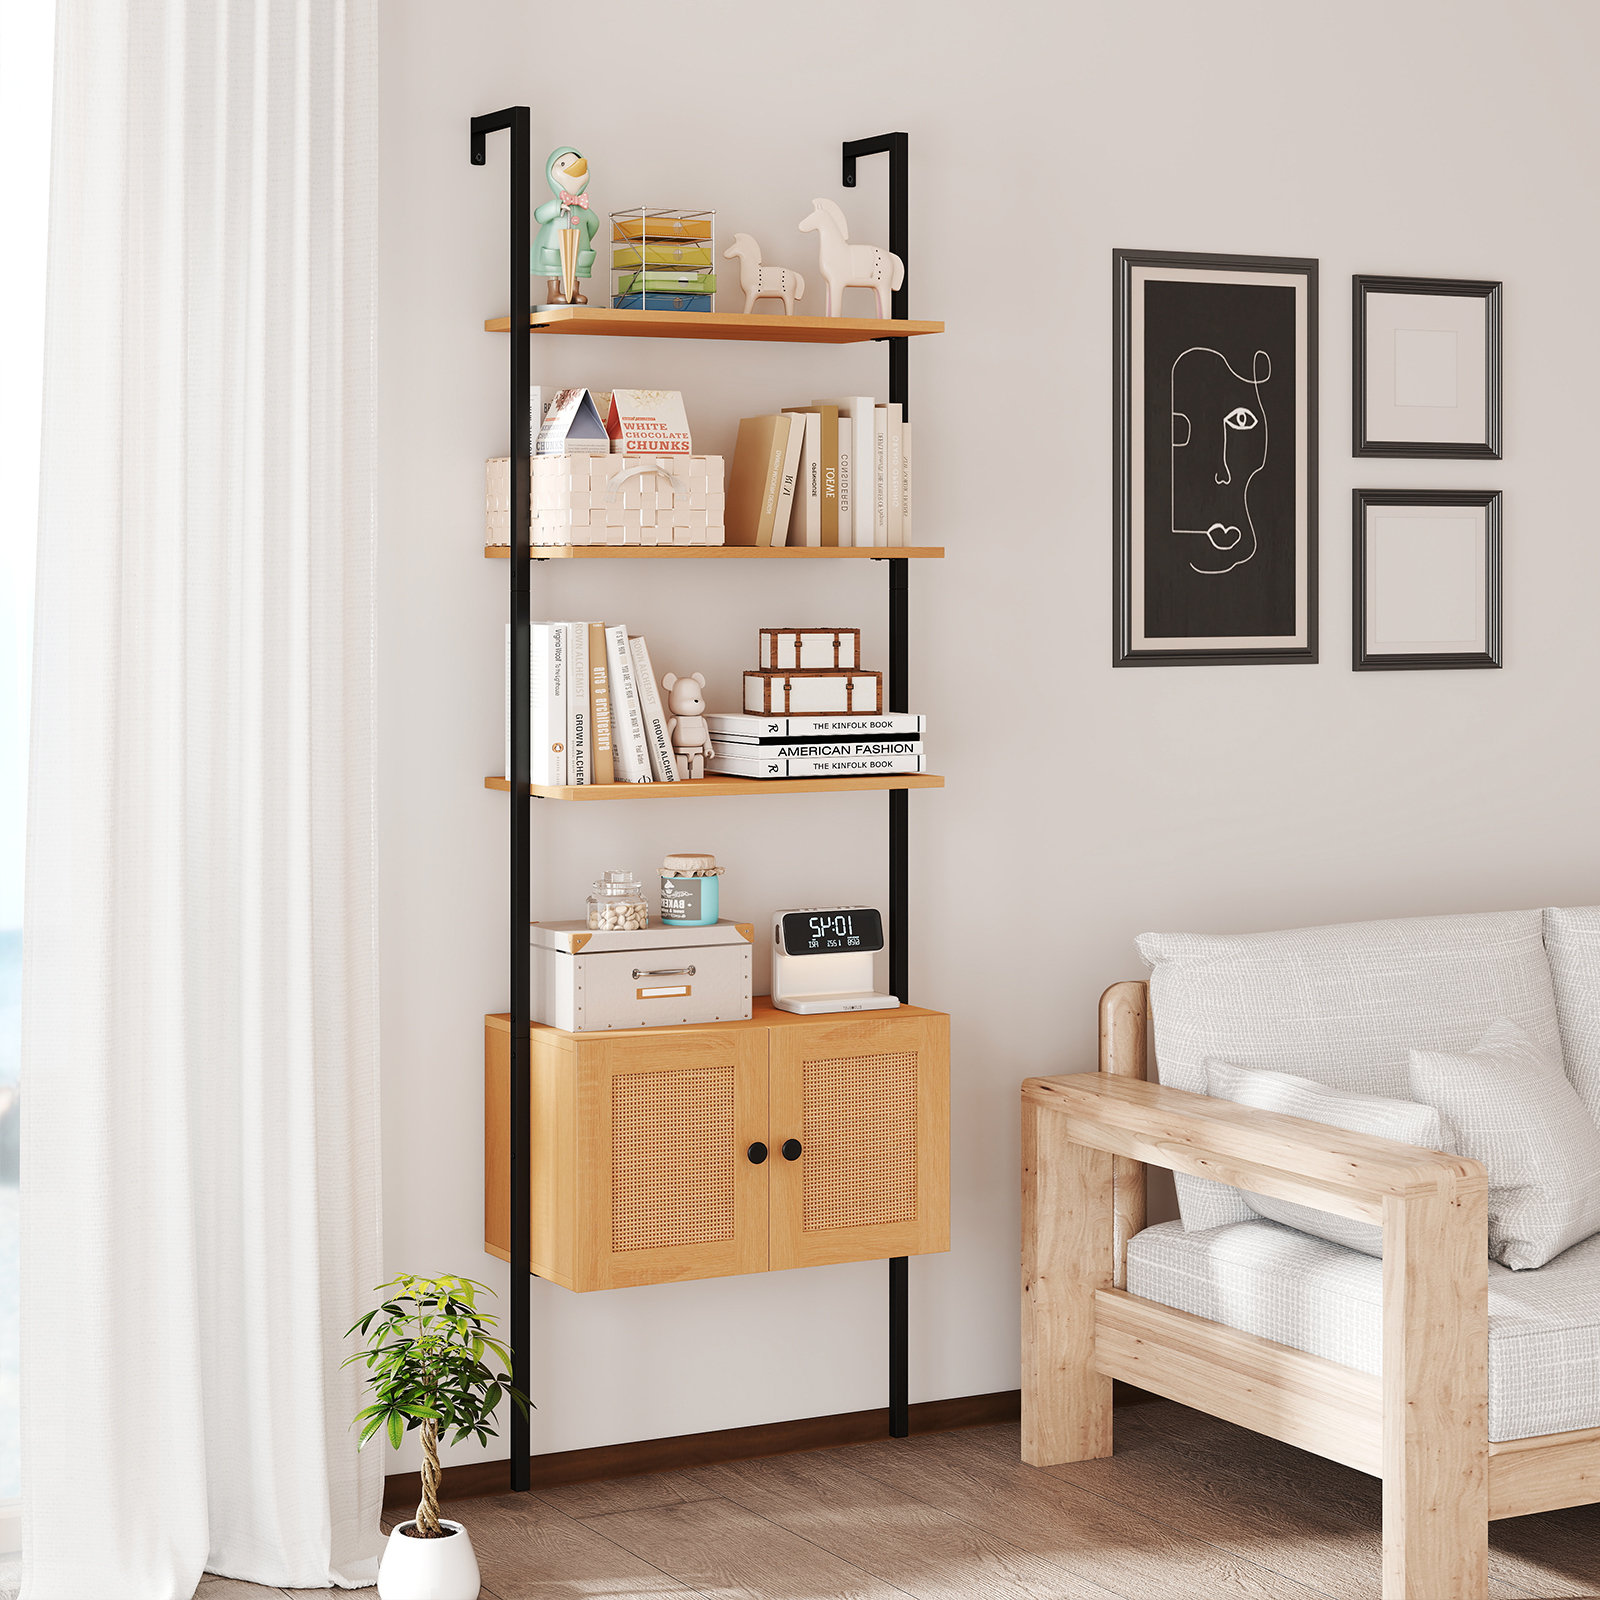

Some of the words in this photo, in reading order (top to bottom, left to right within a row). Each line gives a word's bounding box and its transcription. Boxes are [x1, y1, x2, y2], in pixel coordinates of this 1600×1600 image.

[623, 422, 668, 430] WHITE
[625, 431, 689, 439] CHOCOLATE
[626, 440, 690, 450] CHUNKS
[576, 652, 585, 698] ALCHEMIST
[593, 667, 607, 684] arts
[639, 663, 657, 705] ALCHEMIST
[575, 713, 584, 747] GROWN
[595, 698, 611, 751] architecture
[813, 722, 830, 730] THE
[831, 721, 868, 730] KINFOLK
[869, 721, 893, 729] BOOK
[652, 718, 666, 749] GROWN
[777, 745, 851, 757] AMERICAN
[855, 743, 914, 755] FASHION
[813, 762, 830, 770] THE
[831, 761, 868, 770] KINFOLK
[869, 760, 893, 769] BOOK
